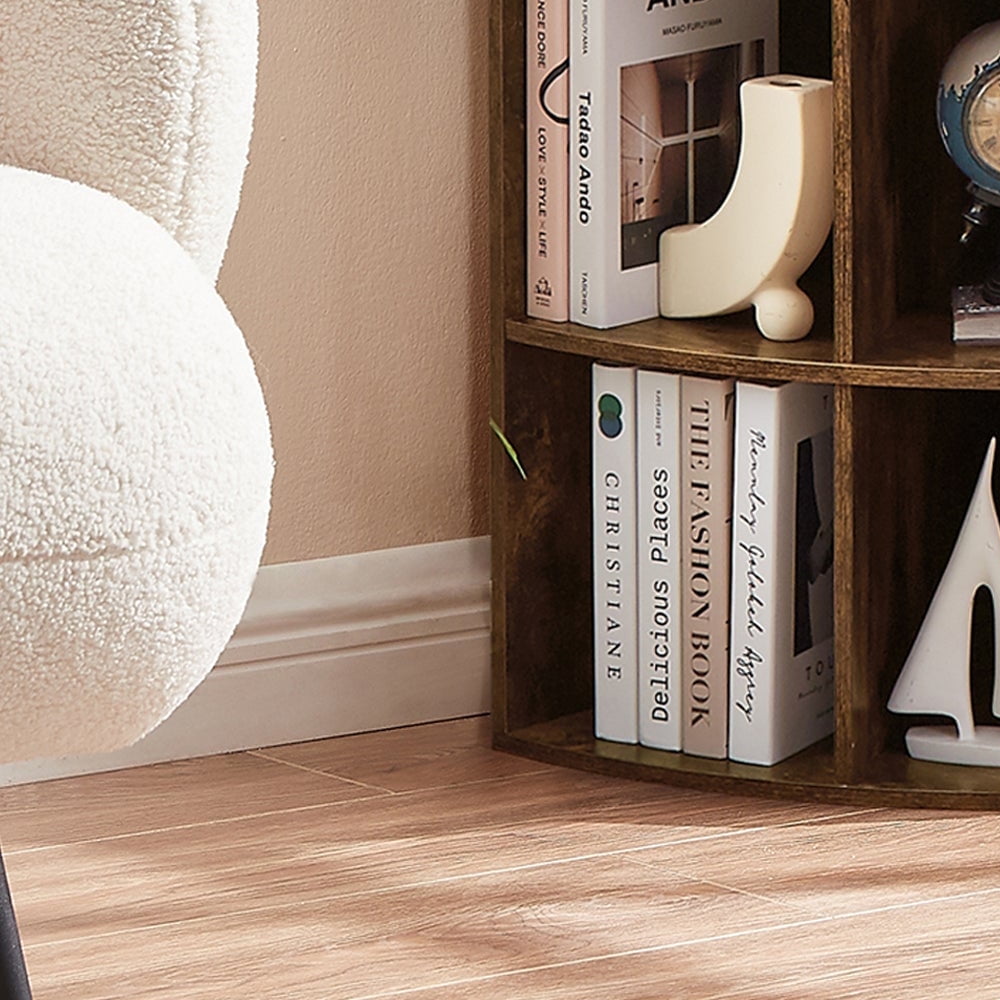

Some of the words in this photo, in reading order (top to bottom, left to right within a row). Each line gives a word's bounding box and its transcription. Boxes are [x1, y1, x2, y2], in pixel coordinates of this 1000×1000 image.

[661, 23, 687, 36] MASAO
[537, 127, 547, 164] LOVE
[578, 91, 592, 160] Tadao
[538, 177, 547, 218] STYLE
[578, 165, 592, 225] Ando
[539, 231, 548, 258] LIFE
[690, 400, 710, 470] THE
[650, 467, 670, 564] Places
[604, 471, 622, 681] CHRISTIANE
[689, 482, 711, 621] FASHION
[651, 579, 670, 723] Delicious
[689, 632, 711, 728] BOOK
